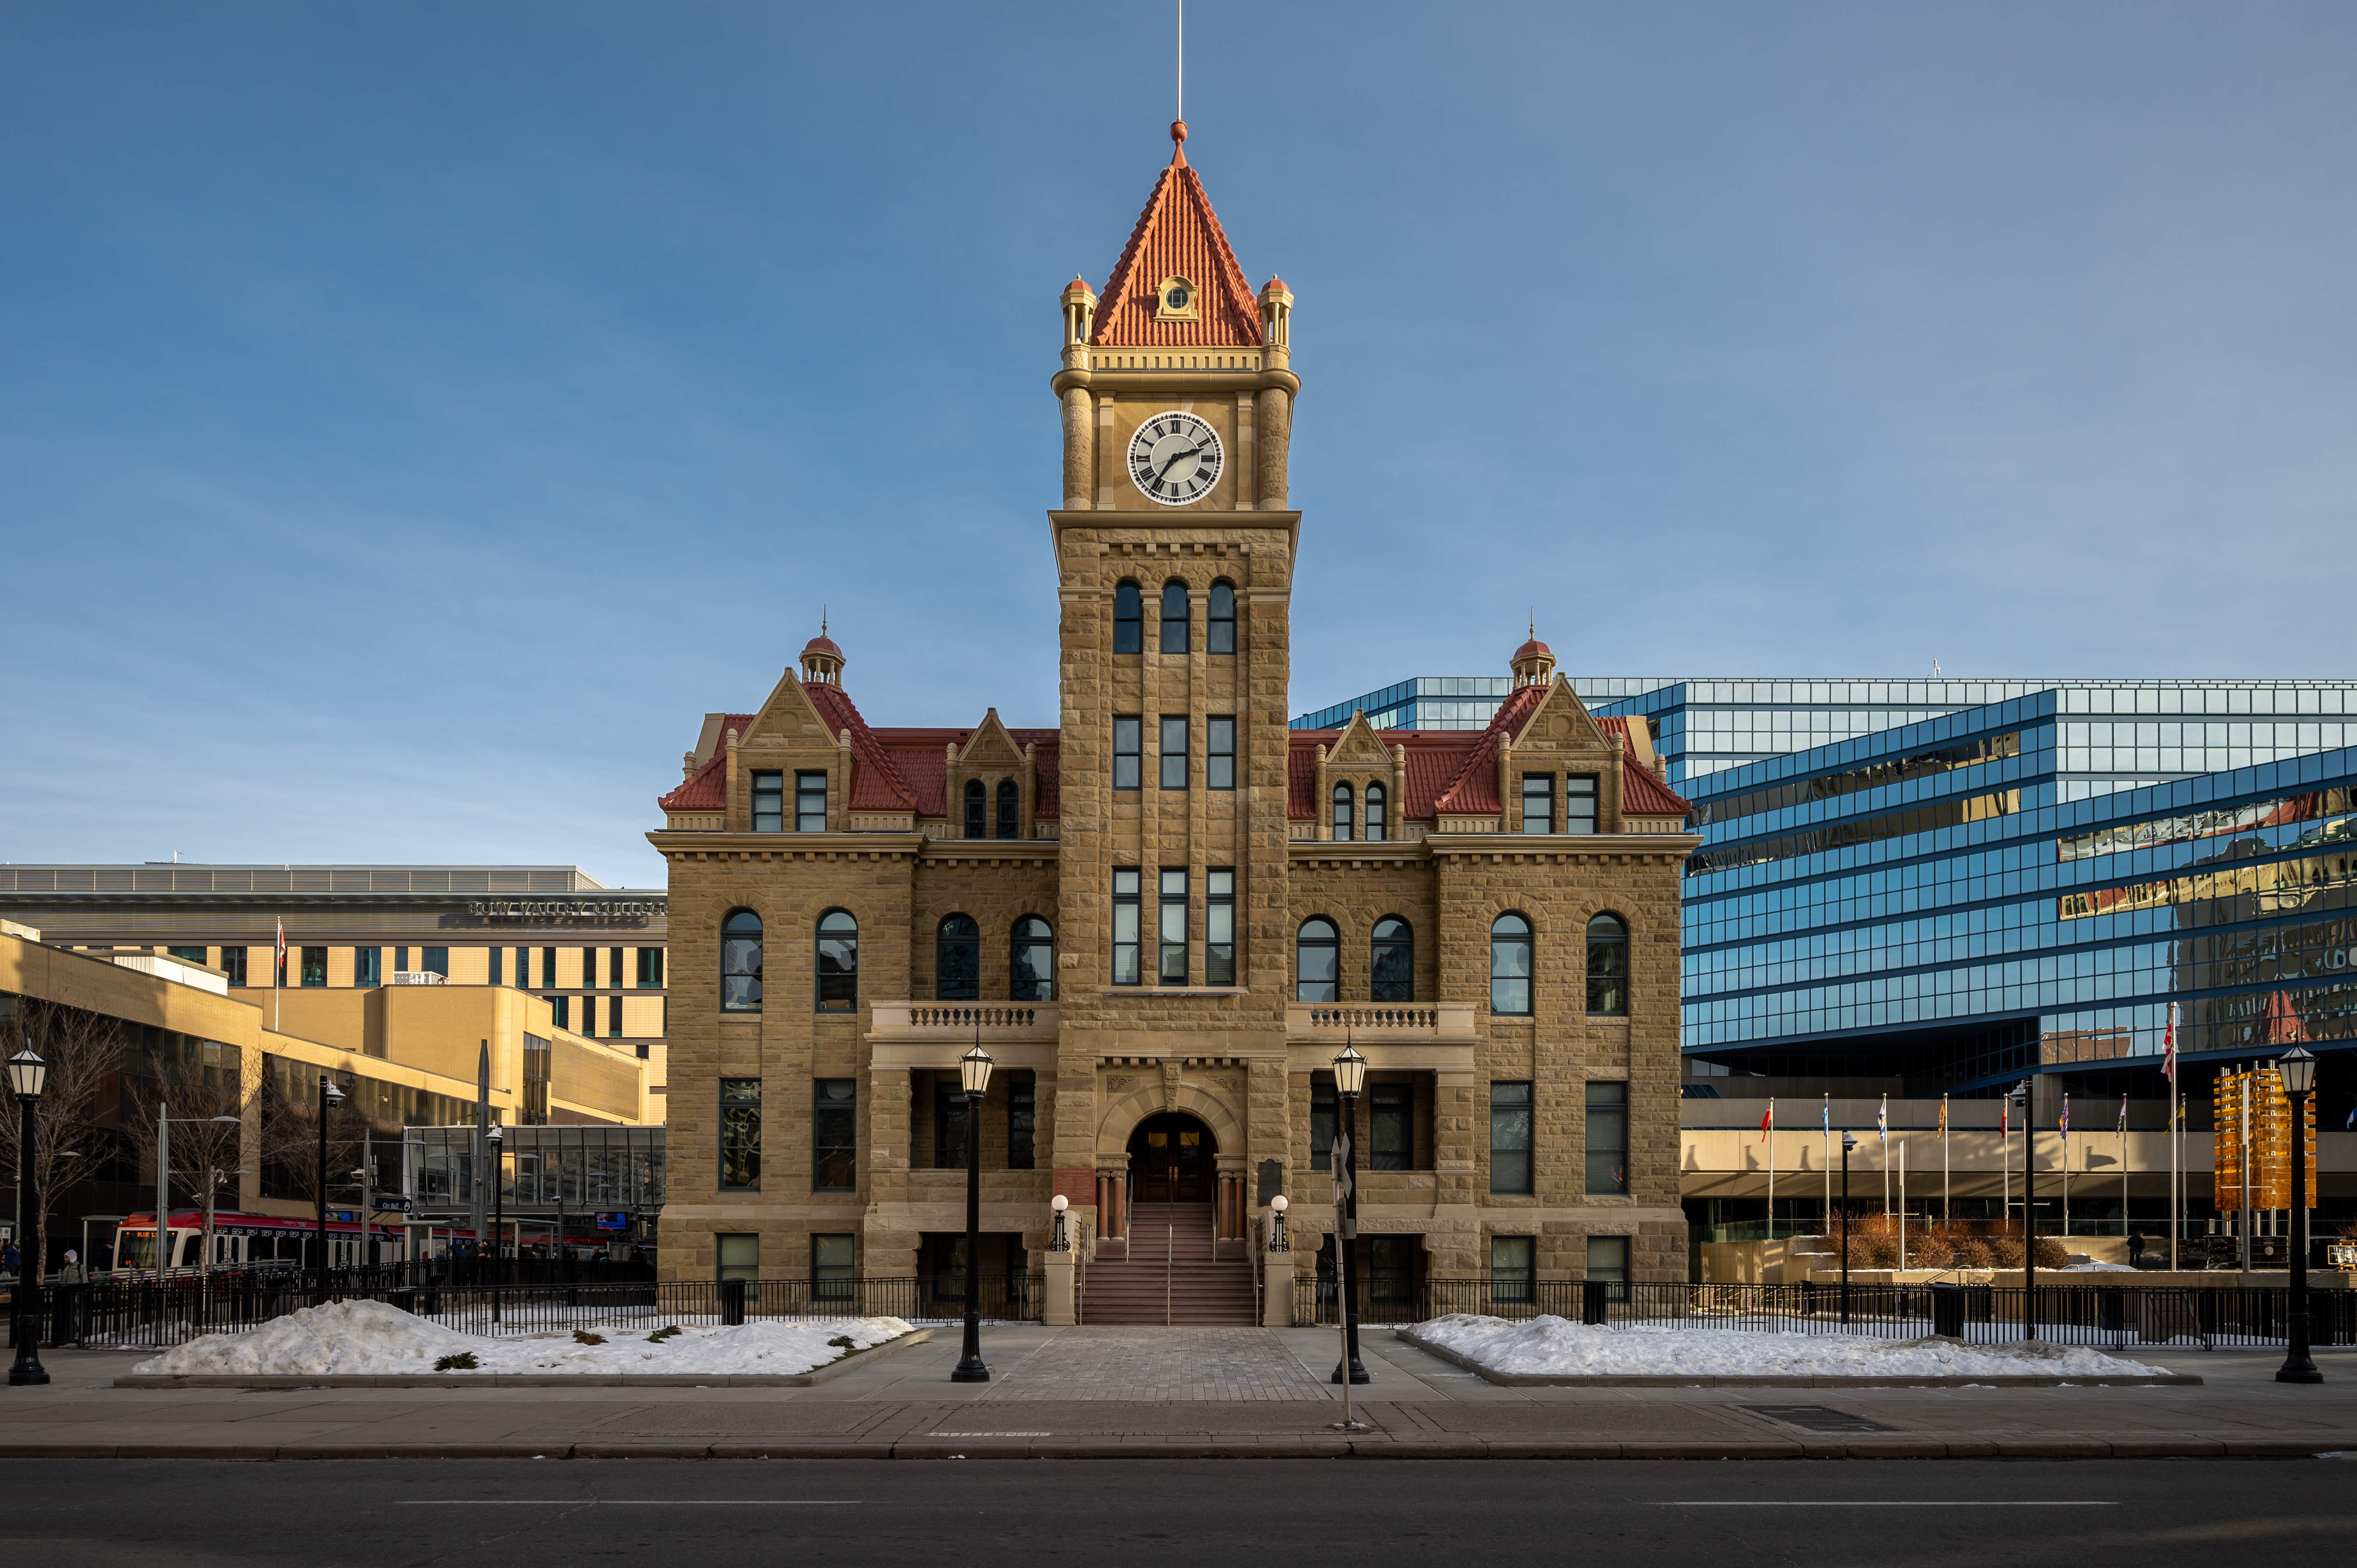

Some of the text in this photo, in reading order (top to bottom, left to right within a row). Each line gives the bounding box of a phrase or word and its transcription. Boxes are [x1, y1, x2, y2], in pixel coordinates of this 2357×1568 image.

[1153, 424, 1166, 438] XI
[1171, 420, 1180, 434] XII
[1188, 425, 1196, 437] I
[1140, 437, 1155, 448] X
[1196, 438, 1211, 448] II
[1139, 465, 1156, 482] VIII
[1195, 467, 1212, 481] IIII
[1172, 483, 1179, 497] VI
[1187, 479, 1197, 493] V
[469, 902, 512, 915] BOW
[519, 902, 587, 915] VALLEY
